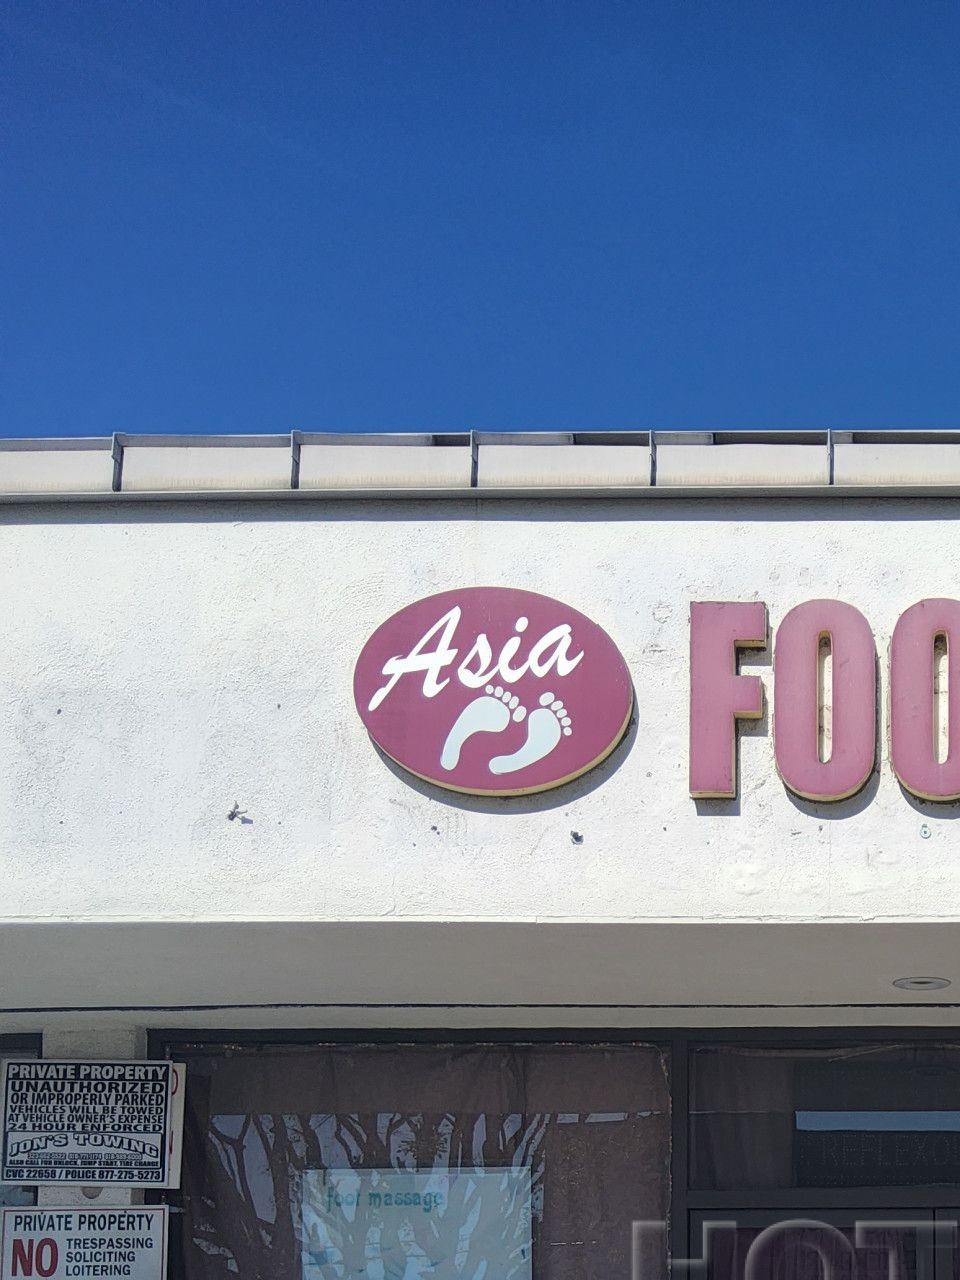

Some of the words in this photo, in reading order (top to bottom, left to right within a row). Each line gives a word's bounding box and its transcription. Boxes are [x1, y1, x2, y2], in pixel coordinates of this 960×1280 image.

[365, 604, 586, 712] Asia
[8, 1064, 75, 1080] PRIVATE
[80, 1065, 166, 1080] PROPERTY
[11, 1082, 164, 1093] UNAUTHORIZED
[11, 1094, 28, 1104] OR
[32, 1093, 111, 1106] IMPROPERLY
[114, 1094, 164, 1106] PARKED
[10, 1105, 66, 1114] VEHICLES
[69, 1106, 98, 1114] WILL
[102, 1106, 117, 1114] BE
[120, 1106, 163, 1115] TOWED
[8, 1114, 20, 1123] AT
[23, 1114, 65, 1123] VEHICLE
[68, 1114, 115, 1124] OWNER'S
[118, 1115, 163, 1124] EXPENSE
[9, 1123, 26, 1131] 24
[32, 1123, 76, 1132] HOUR
[82, 1124, 162, 1132] ENFORCED
[9, 1133, 68, 1156] JON'S
[73, 1133, 159, 1158] TOWING
[6, 1169, 24, 1179] CVC
[58, 1170, 63, 1180] /
[65, 1170, 96, 1180] POLICE
[368, 1191, 443, 1213] massage
[14, 1214, 72, 1232] PRIVATE
[78, 1214, 154, 1231] PROPERTY
[66, 1238, 154, 1249] TRESPASSING
[11, 1238, 59, 1277] NO
[66, 1252, 136, 1262] SOLICITING
[66, 1265, 131, 1276] LOITERING
